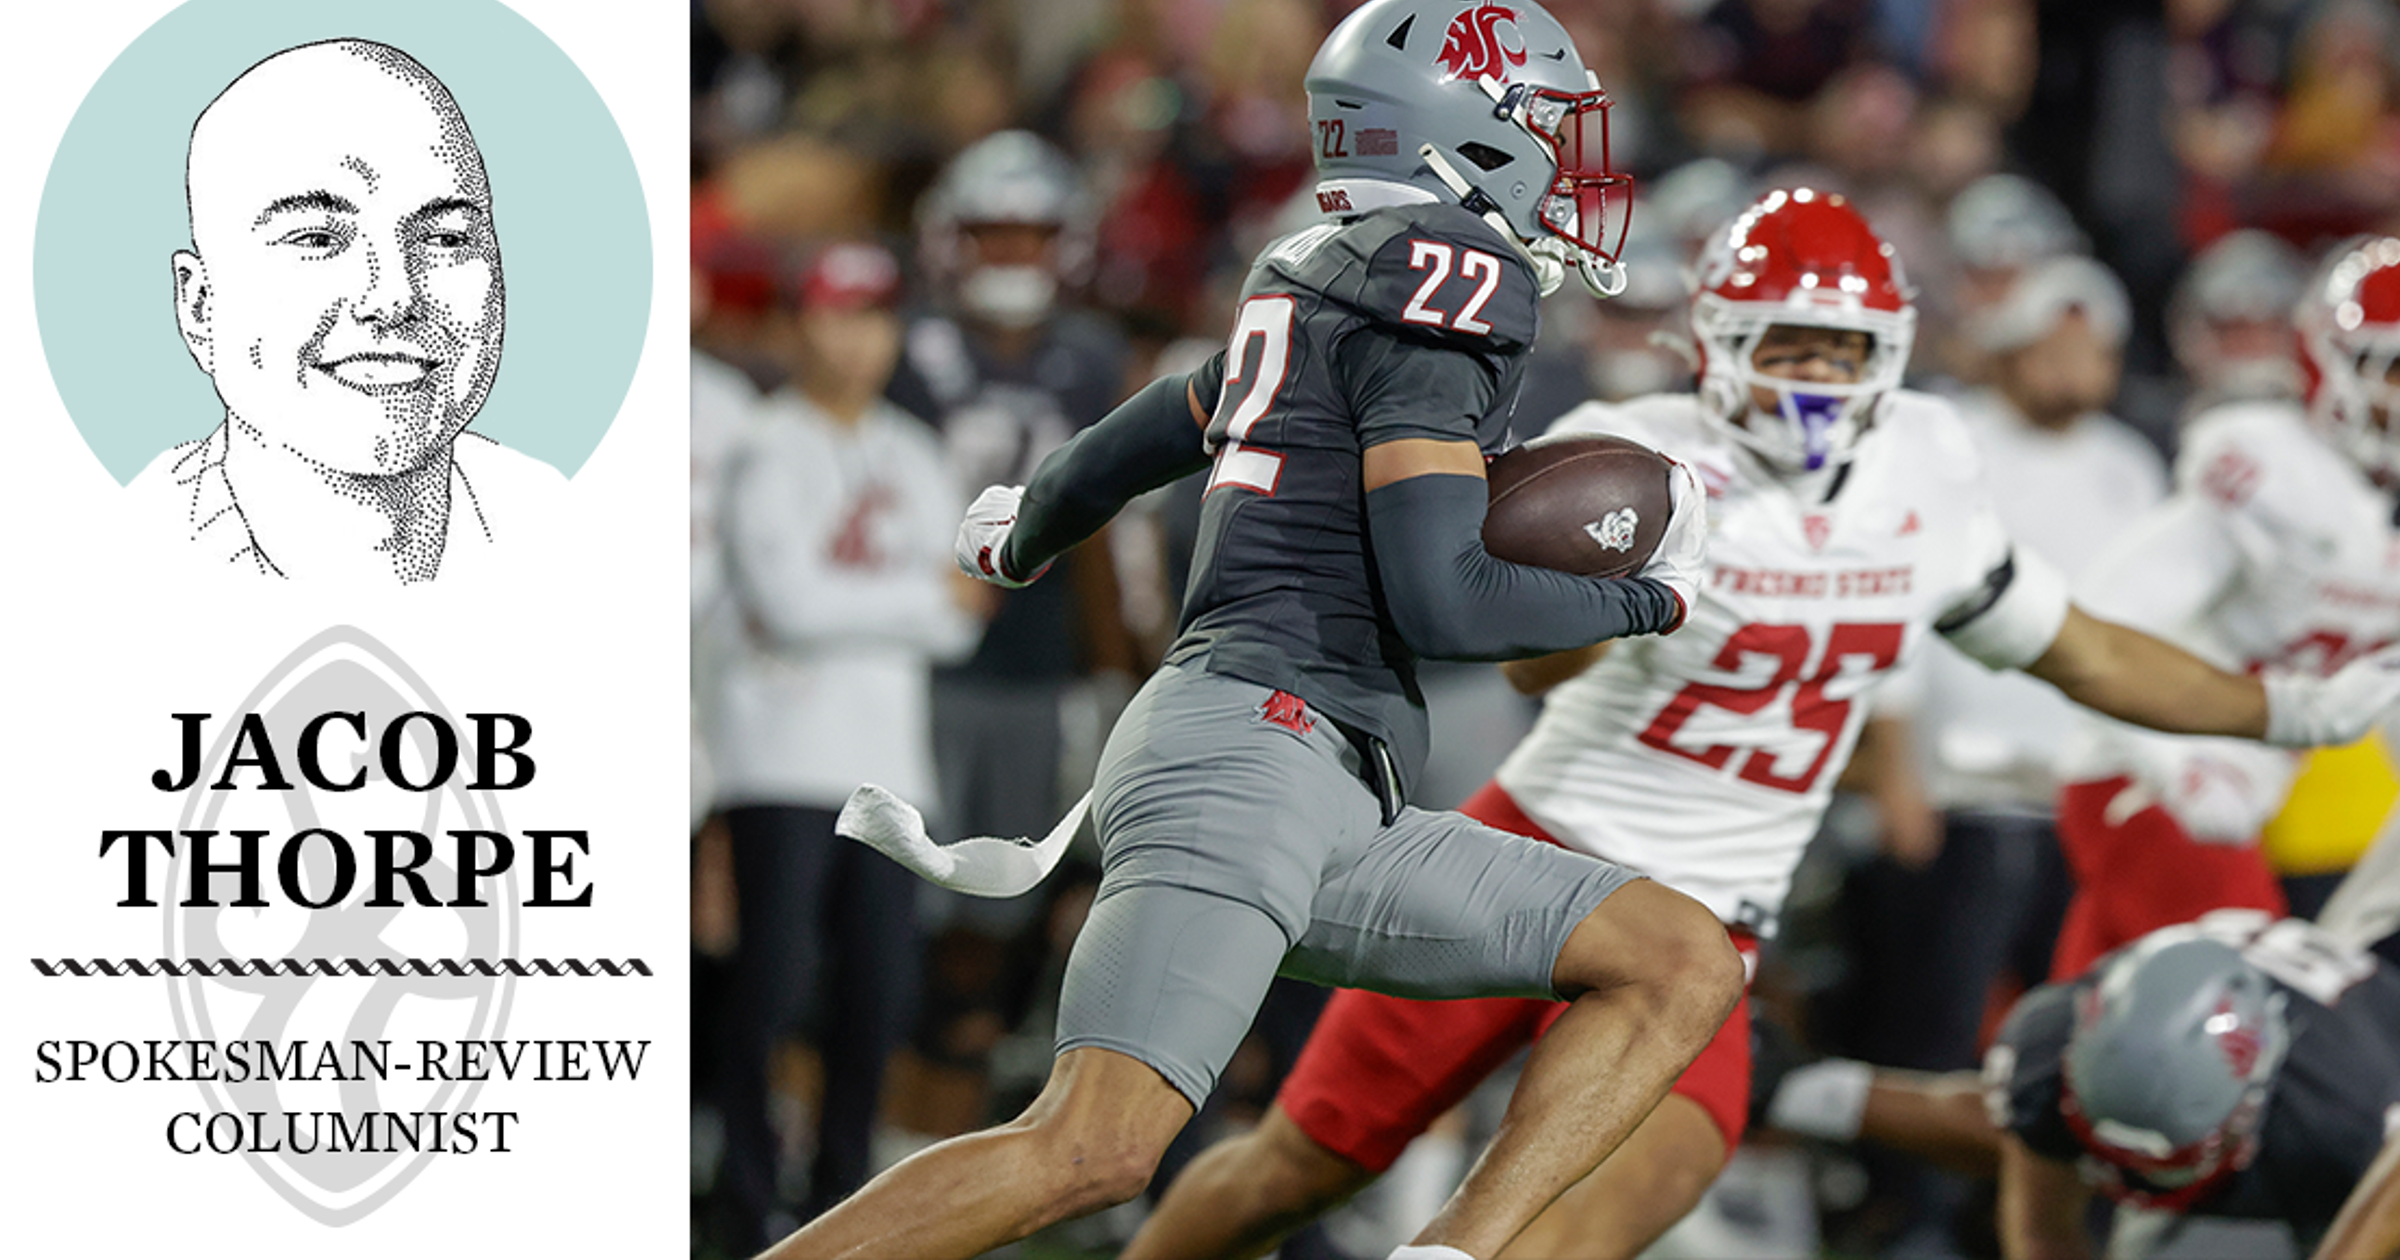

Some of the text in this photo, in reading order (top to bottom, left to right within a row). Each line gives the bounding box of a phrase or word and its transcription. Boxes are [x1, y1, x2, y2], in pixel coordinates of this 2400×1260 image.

[1318, 119, 1348, 158] 22
[1400, 238, 1502, 337] 22
[1836, 564, 1914, 598] STATE
[1637, 620, 1905, 793] 25
